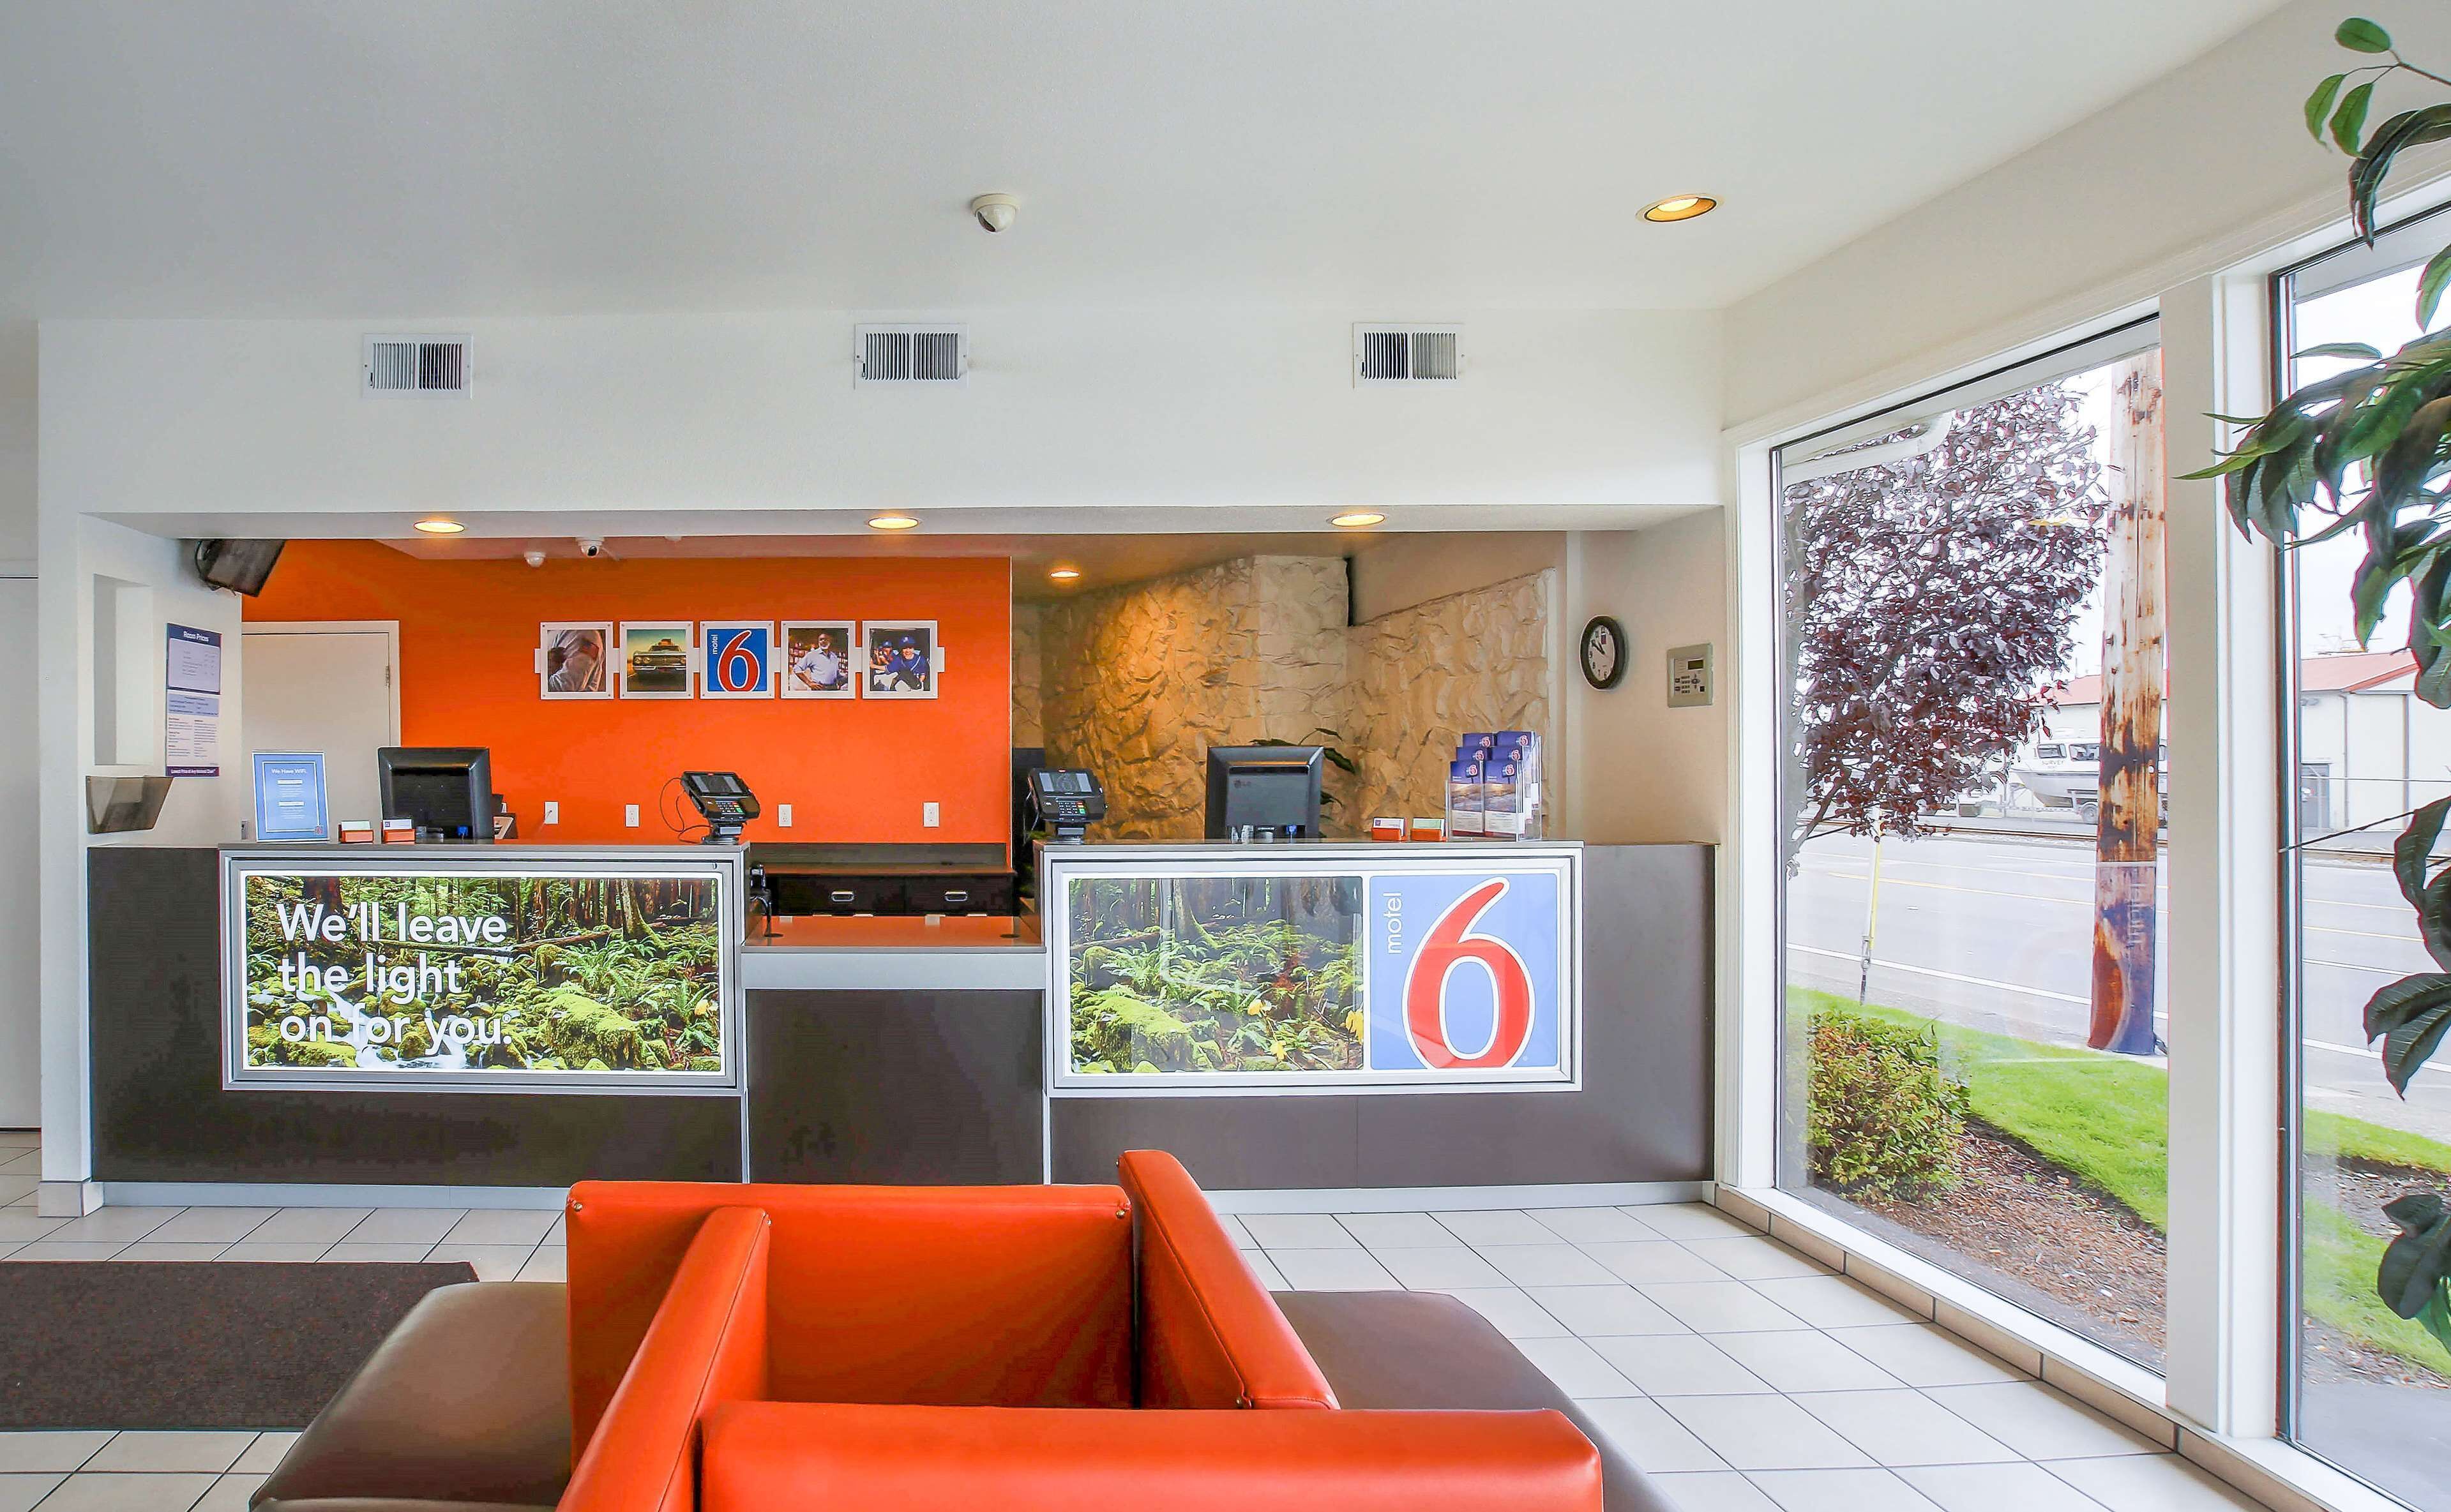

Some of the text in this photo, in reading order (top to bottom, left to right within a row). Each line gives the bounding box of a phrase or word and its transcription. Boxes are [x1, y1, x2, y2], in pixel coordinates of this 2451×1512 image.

[183, 631, 209, 642] Room Prices
[718, 630, 760, 692] 6
[276, 902, 507, 943] We'll leave
[1382, 892, 1403, 955] motel
[277, 952, 462, 1005] the light
[1401, 876, 1536, 1070] 6
[280, 1015, 333, 1043] on
[347, 1002, 411, 1044] for
